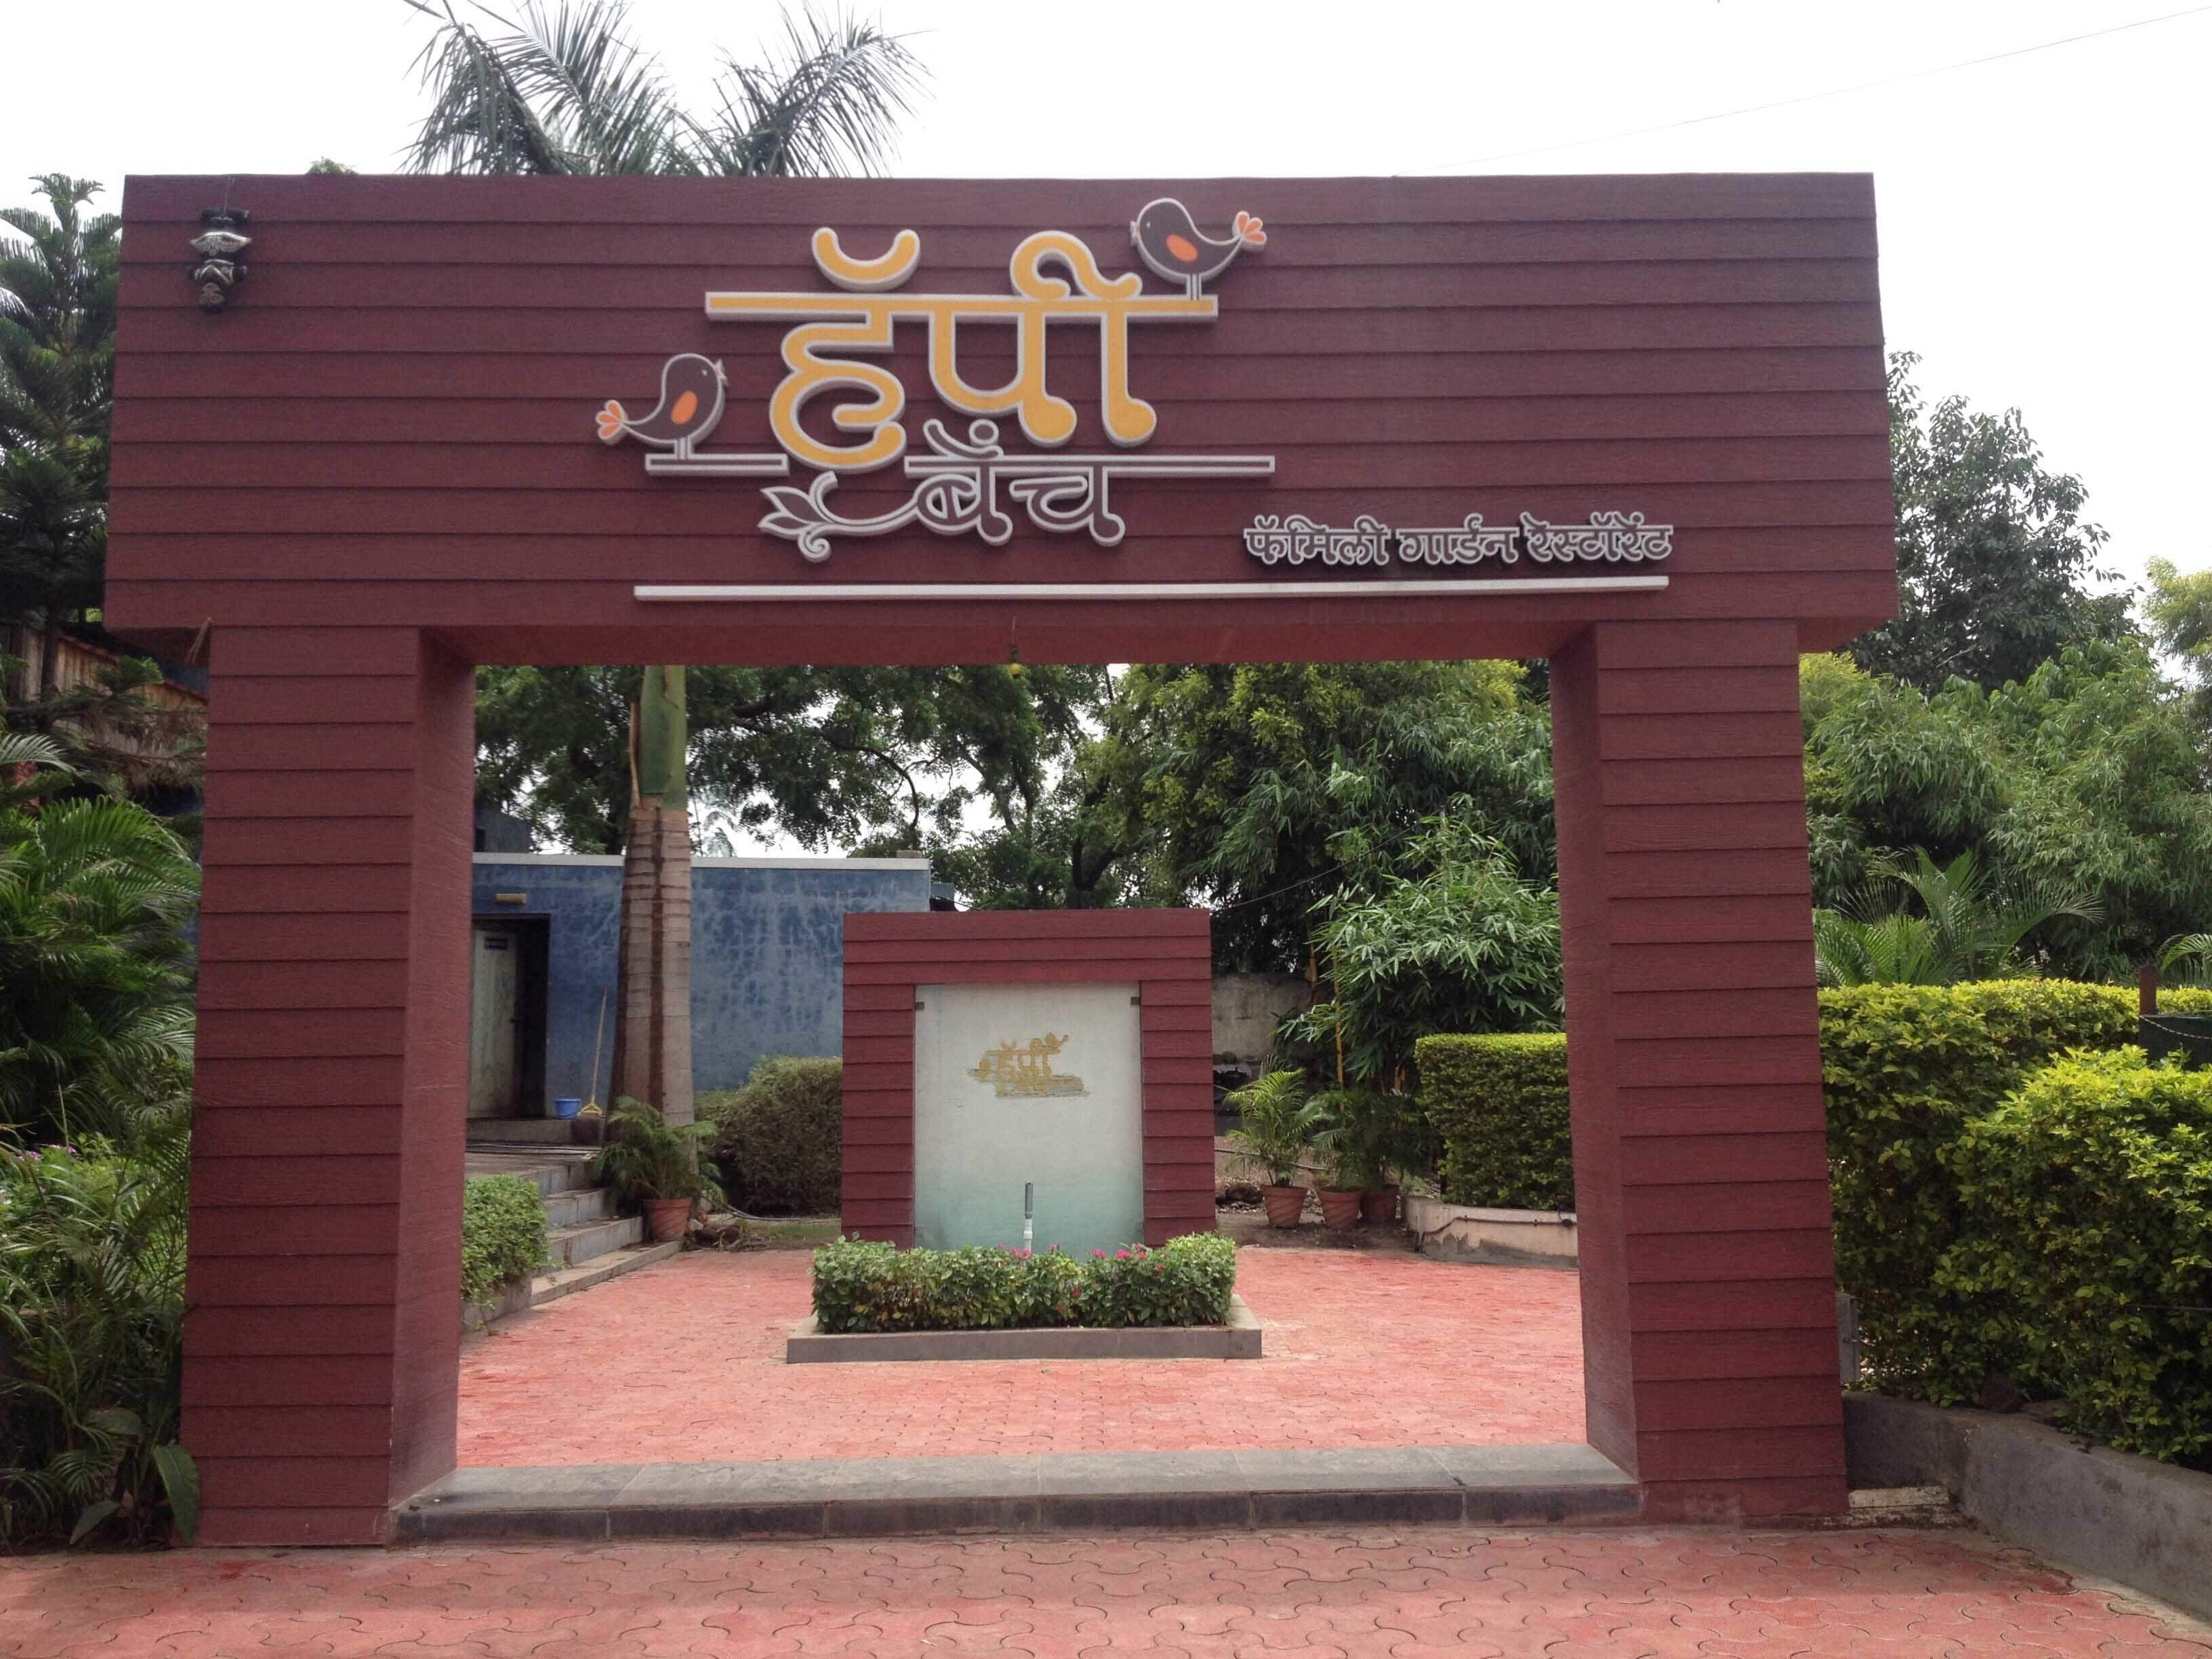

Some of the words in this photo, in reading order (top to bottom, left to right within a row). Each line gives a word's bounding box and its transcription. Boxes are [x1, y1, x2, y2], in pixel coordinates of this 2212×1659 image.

[904, 419, 1275, 545] बेंच
[1244, 514, 1392, 566] फॅमिली
[1396, 512, 1519, 565] गार्डन
[1520, 511, 1673, 563] रेस्टॉरेंट
